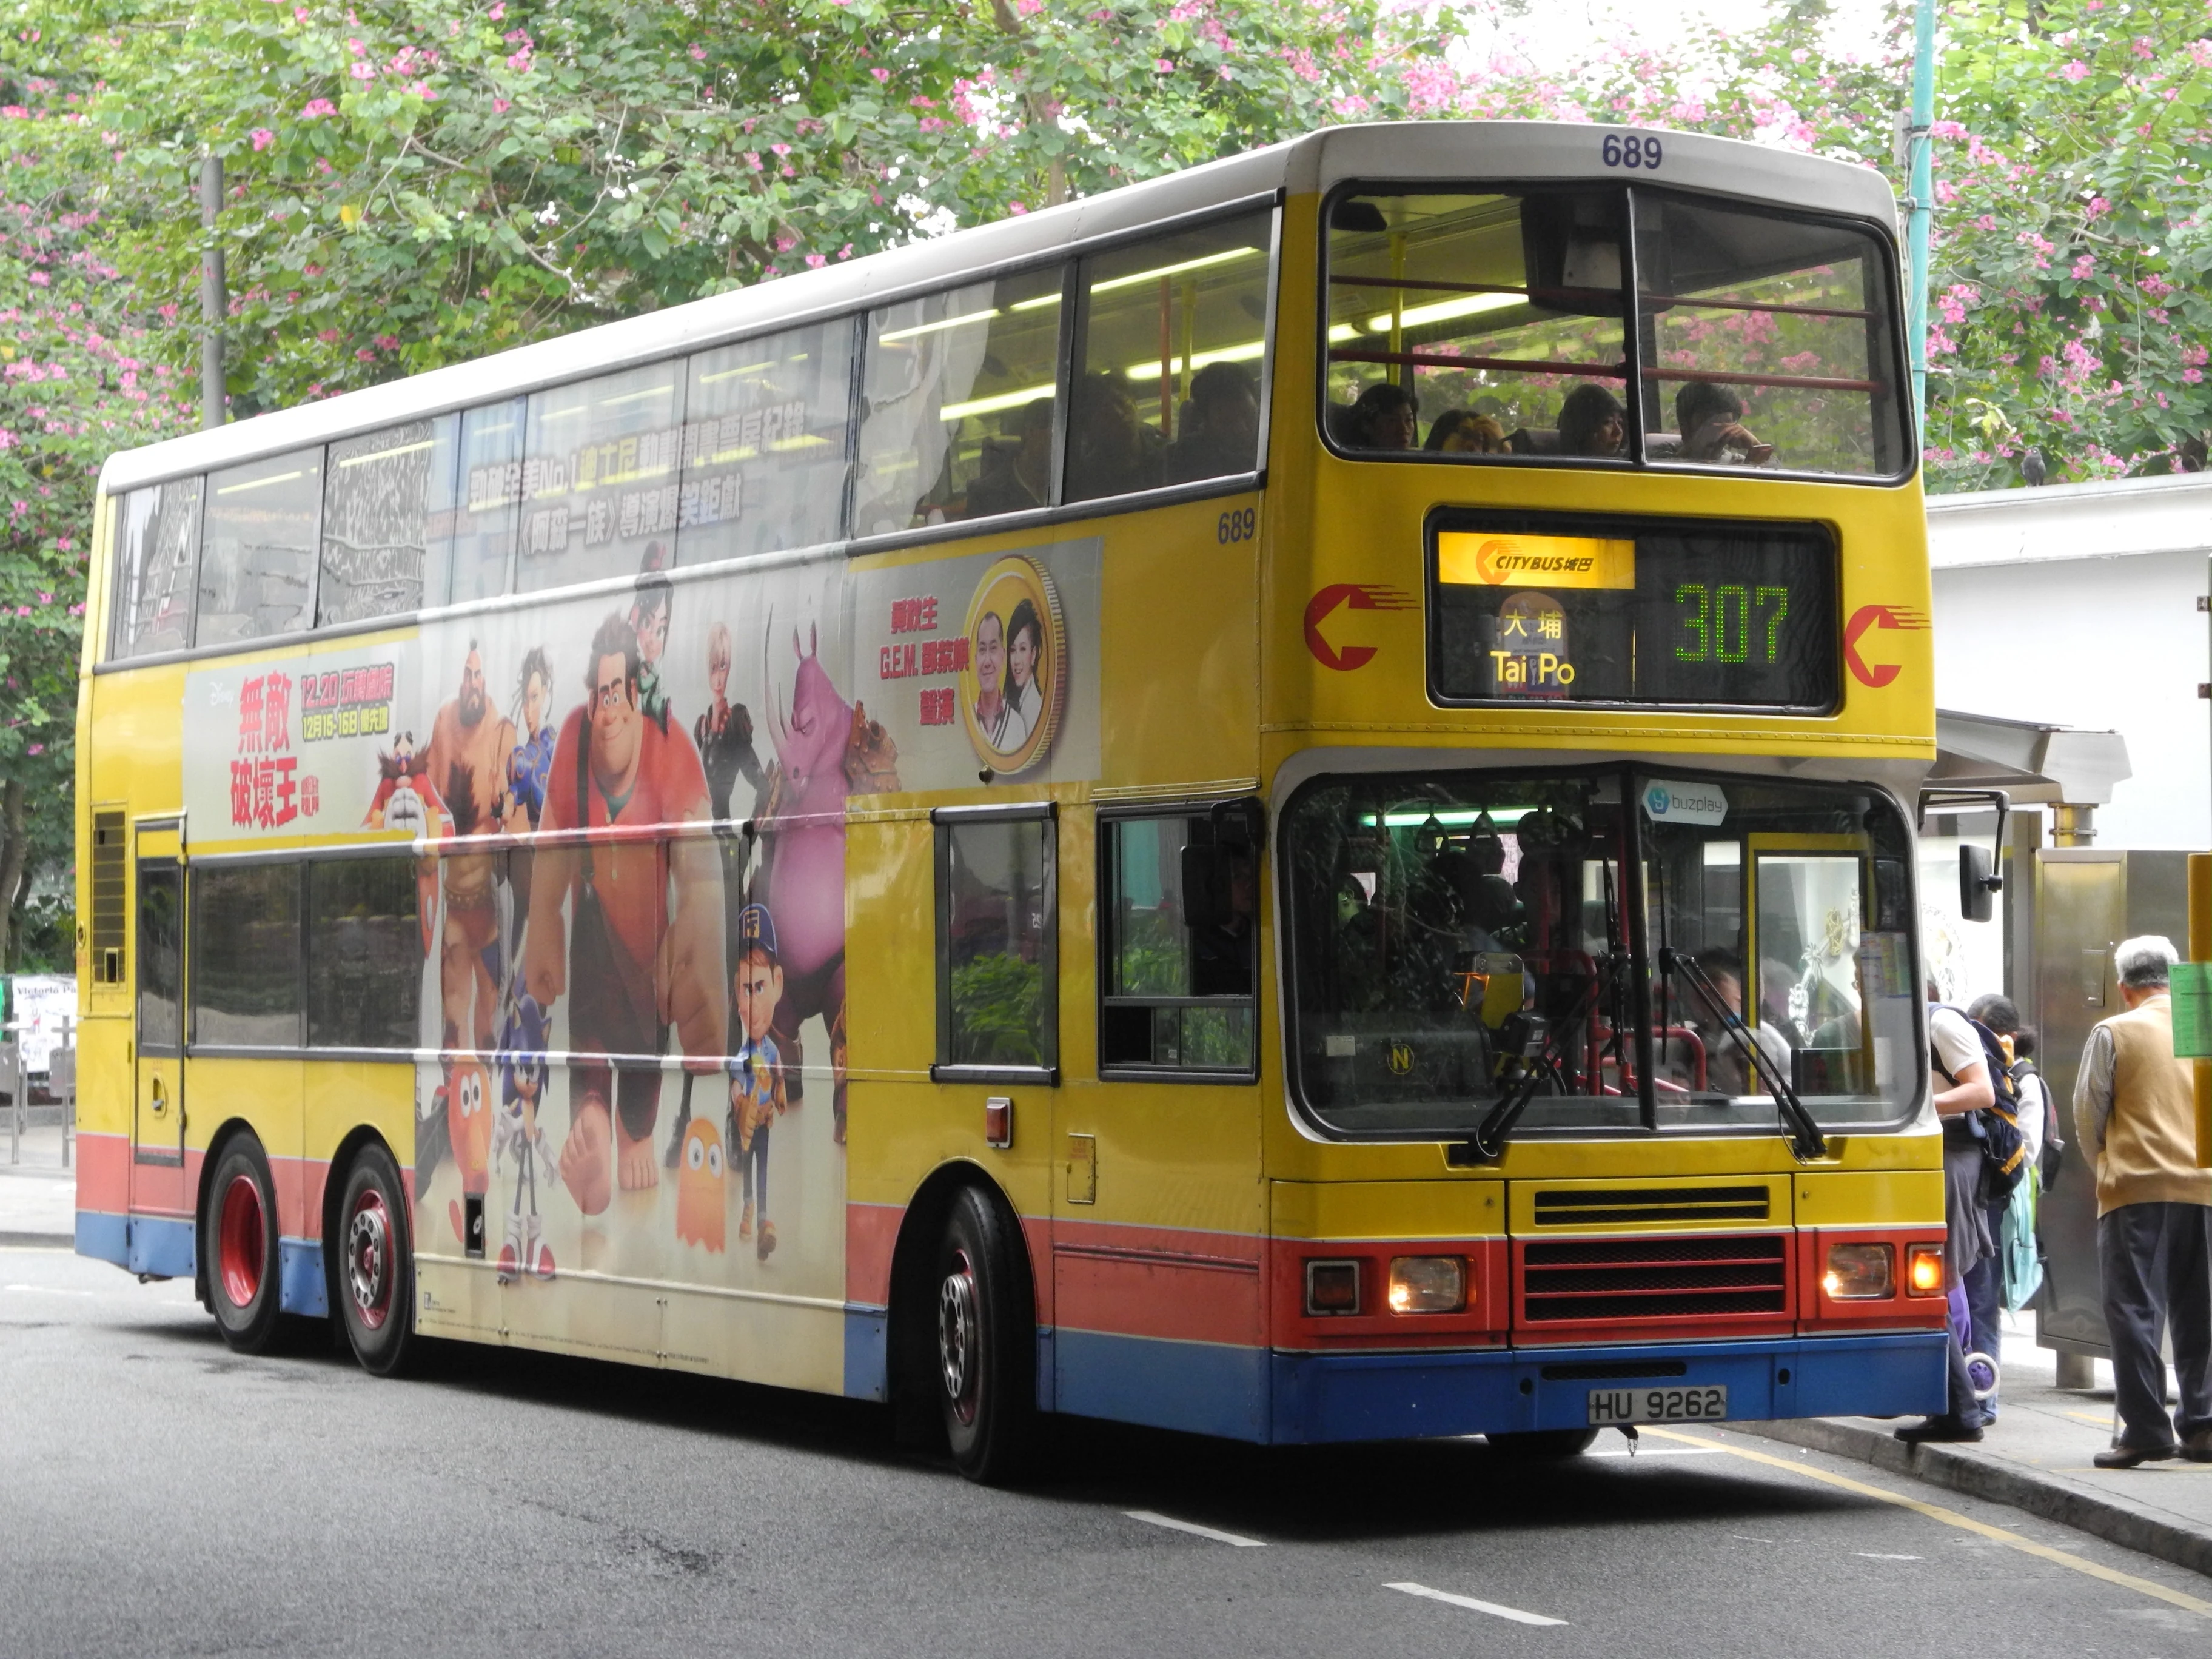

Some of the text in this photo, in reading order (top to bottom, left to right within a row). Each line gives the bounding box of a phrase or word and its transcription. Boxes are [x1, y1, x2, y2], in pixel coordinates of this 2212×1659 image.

[1602, 133, 1663, 169] 689
[1218, 508, 1255, 545] 689
[891, 594, 938, 634] 黃秋生
[1504, 608, 1563, 640] 大埔
[1677, 584, 1788, 664] 307
[880, 642, 919, 680] G.E.M.
[1490, 651, 1575, 685] Tai Po
[301, 671, 339, 709] 12.20
[919, 686, 955, 725] 聲演
[238, 670, 292, 754] 無敵
[230, 756, 298, 831] 破壞王
[1672, 794, 1722, 814] buzplay
[16, 986, 59, 996] Victoria
[1393, 1048, 1409, 1070] N
[1594, 1389, 1722, 1421] HU 9262
